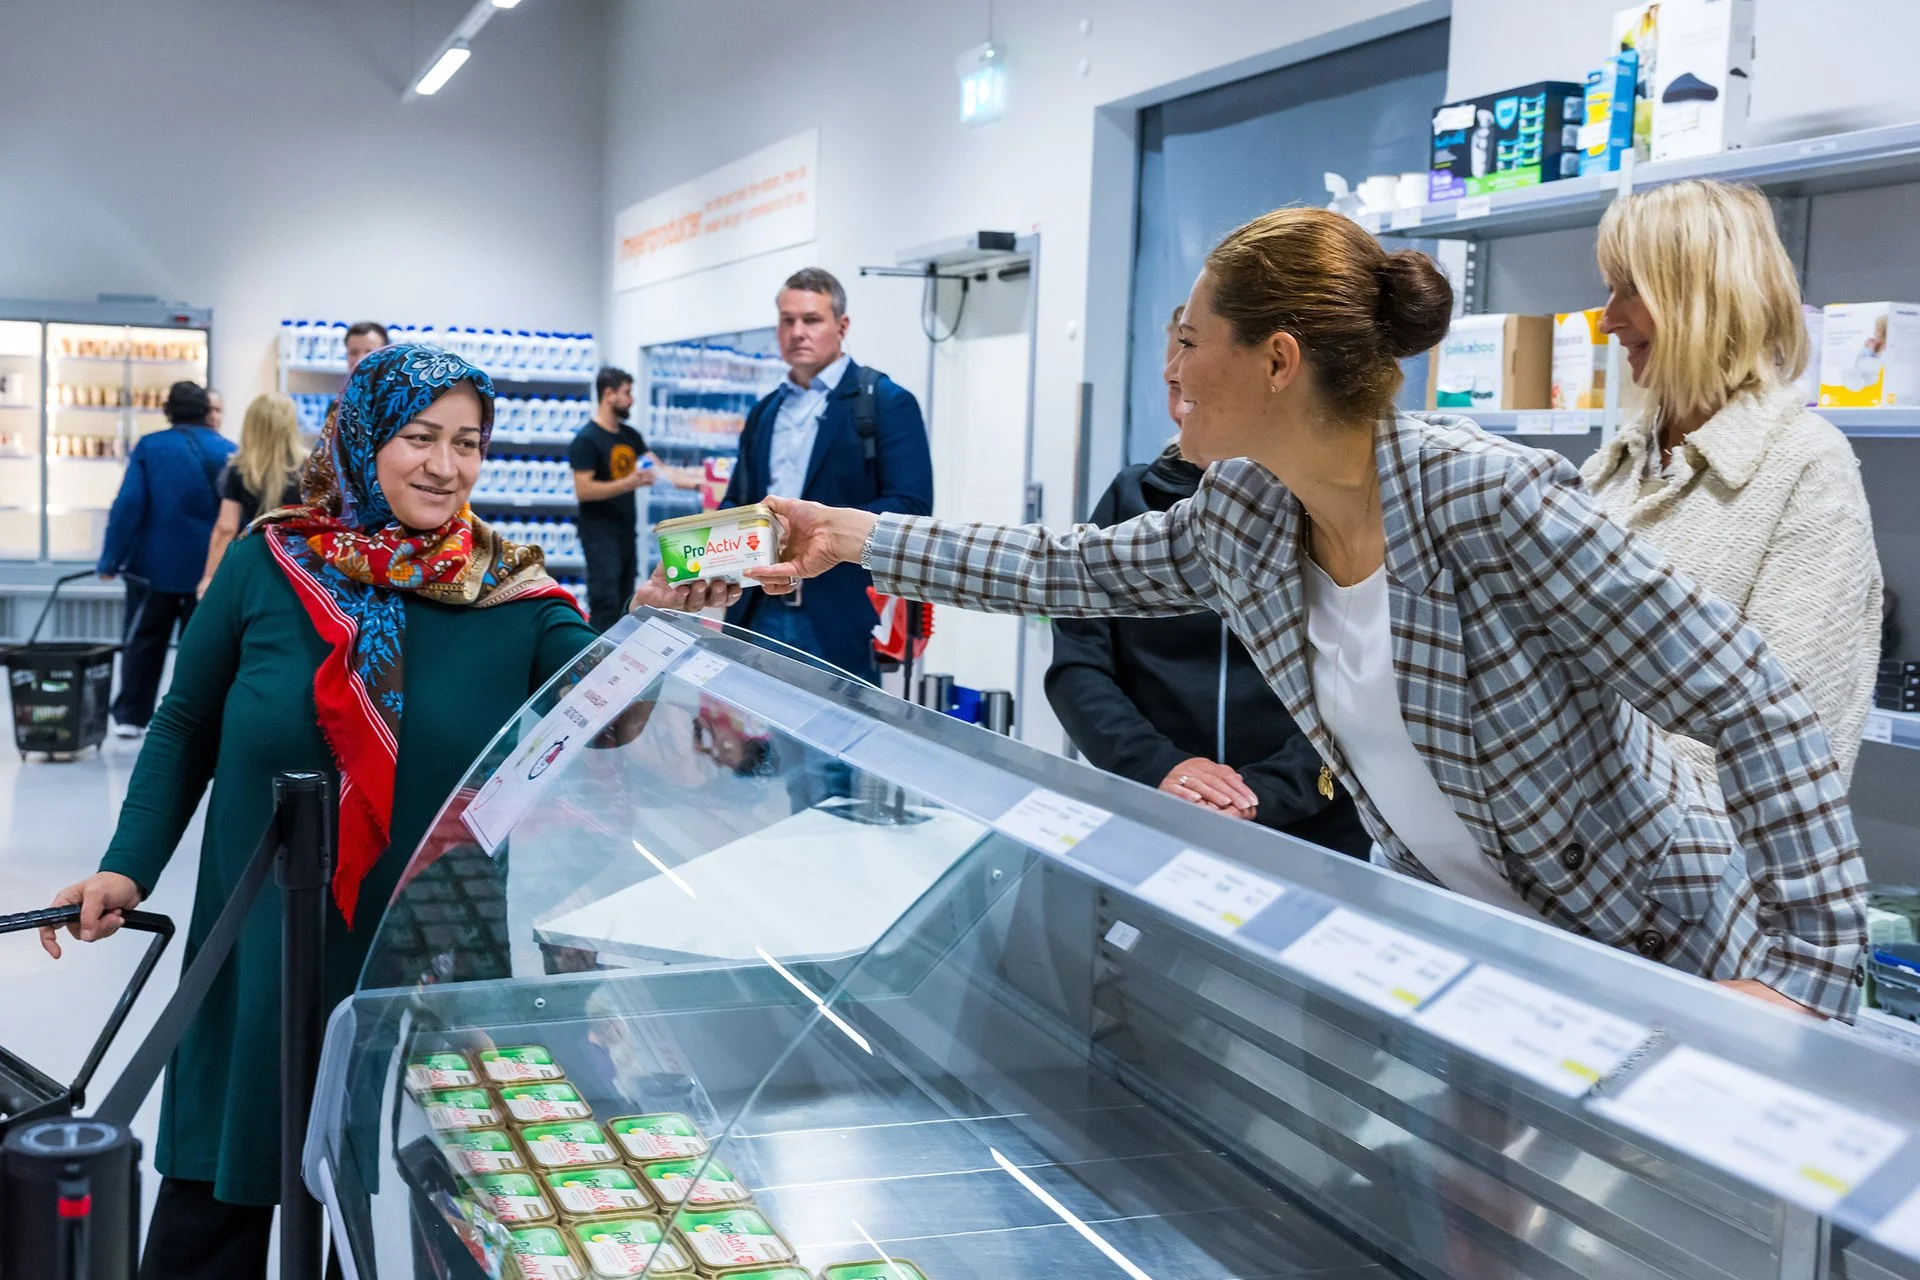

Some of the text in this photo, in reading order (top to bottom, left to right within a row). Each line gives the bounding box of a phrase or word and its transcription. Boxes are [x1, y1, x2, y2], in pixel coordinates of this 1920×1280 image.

[683, 535, 742, 559] ProActiv
[612, 1231, 646, 1264] ProActiv
[714, 1221, 755, 1252] ProActiv
